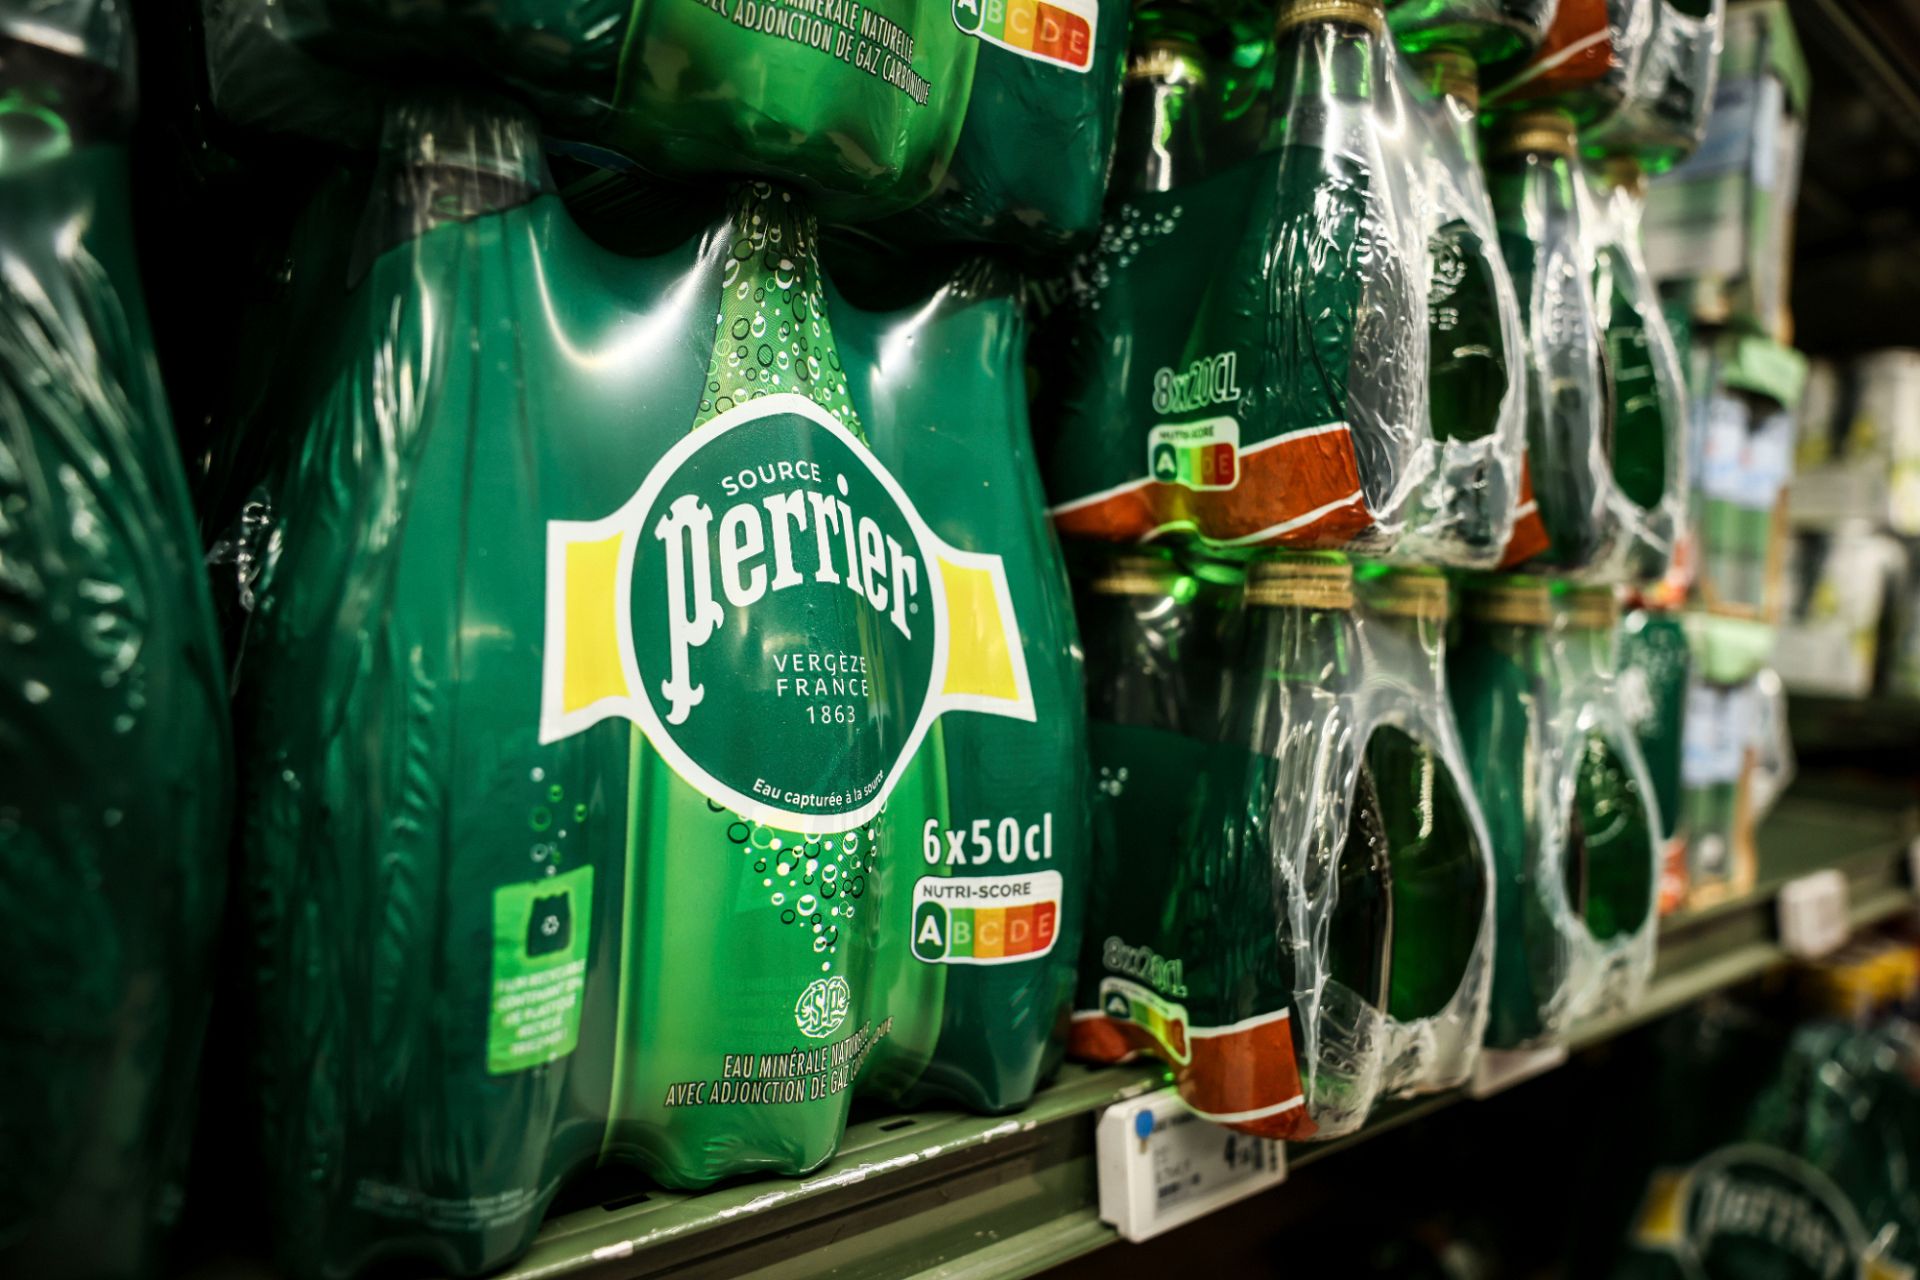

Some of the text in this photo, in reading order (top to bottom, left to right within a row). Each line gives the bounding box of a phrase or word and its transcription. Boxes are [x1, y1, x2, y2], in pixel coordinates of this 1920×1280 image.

[734, 0, 833, 51] ADJONCTION
[836, 31, 855, 62] DE
[856, 41, 882, 75] GAZ
[883, 55, 931, 104] CARBONIQUE
[861, 9, 914, 63] NATURELLE
[721, 460, 822, 496] SOURCE
[773, 650, 867, 677] VERGÈZE
[776, 678, 869, 697] FRANCE
[805, 704, 856, 724] 1863
[752, 769, 884, 808] Eau capturée à la source
[923, 812, 1053, 865] 6x50cl
[922, 881, 1032, 898] NUTRI-SCORE
[723, 1055, 755, 1078] EAU
[759, 1047, 828, 1078] MINÉRALE
[665, 1068, 849, 1106] AVEC ADJONCTION DE GAZ
